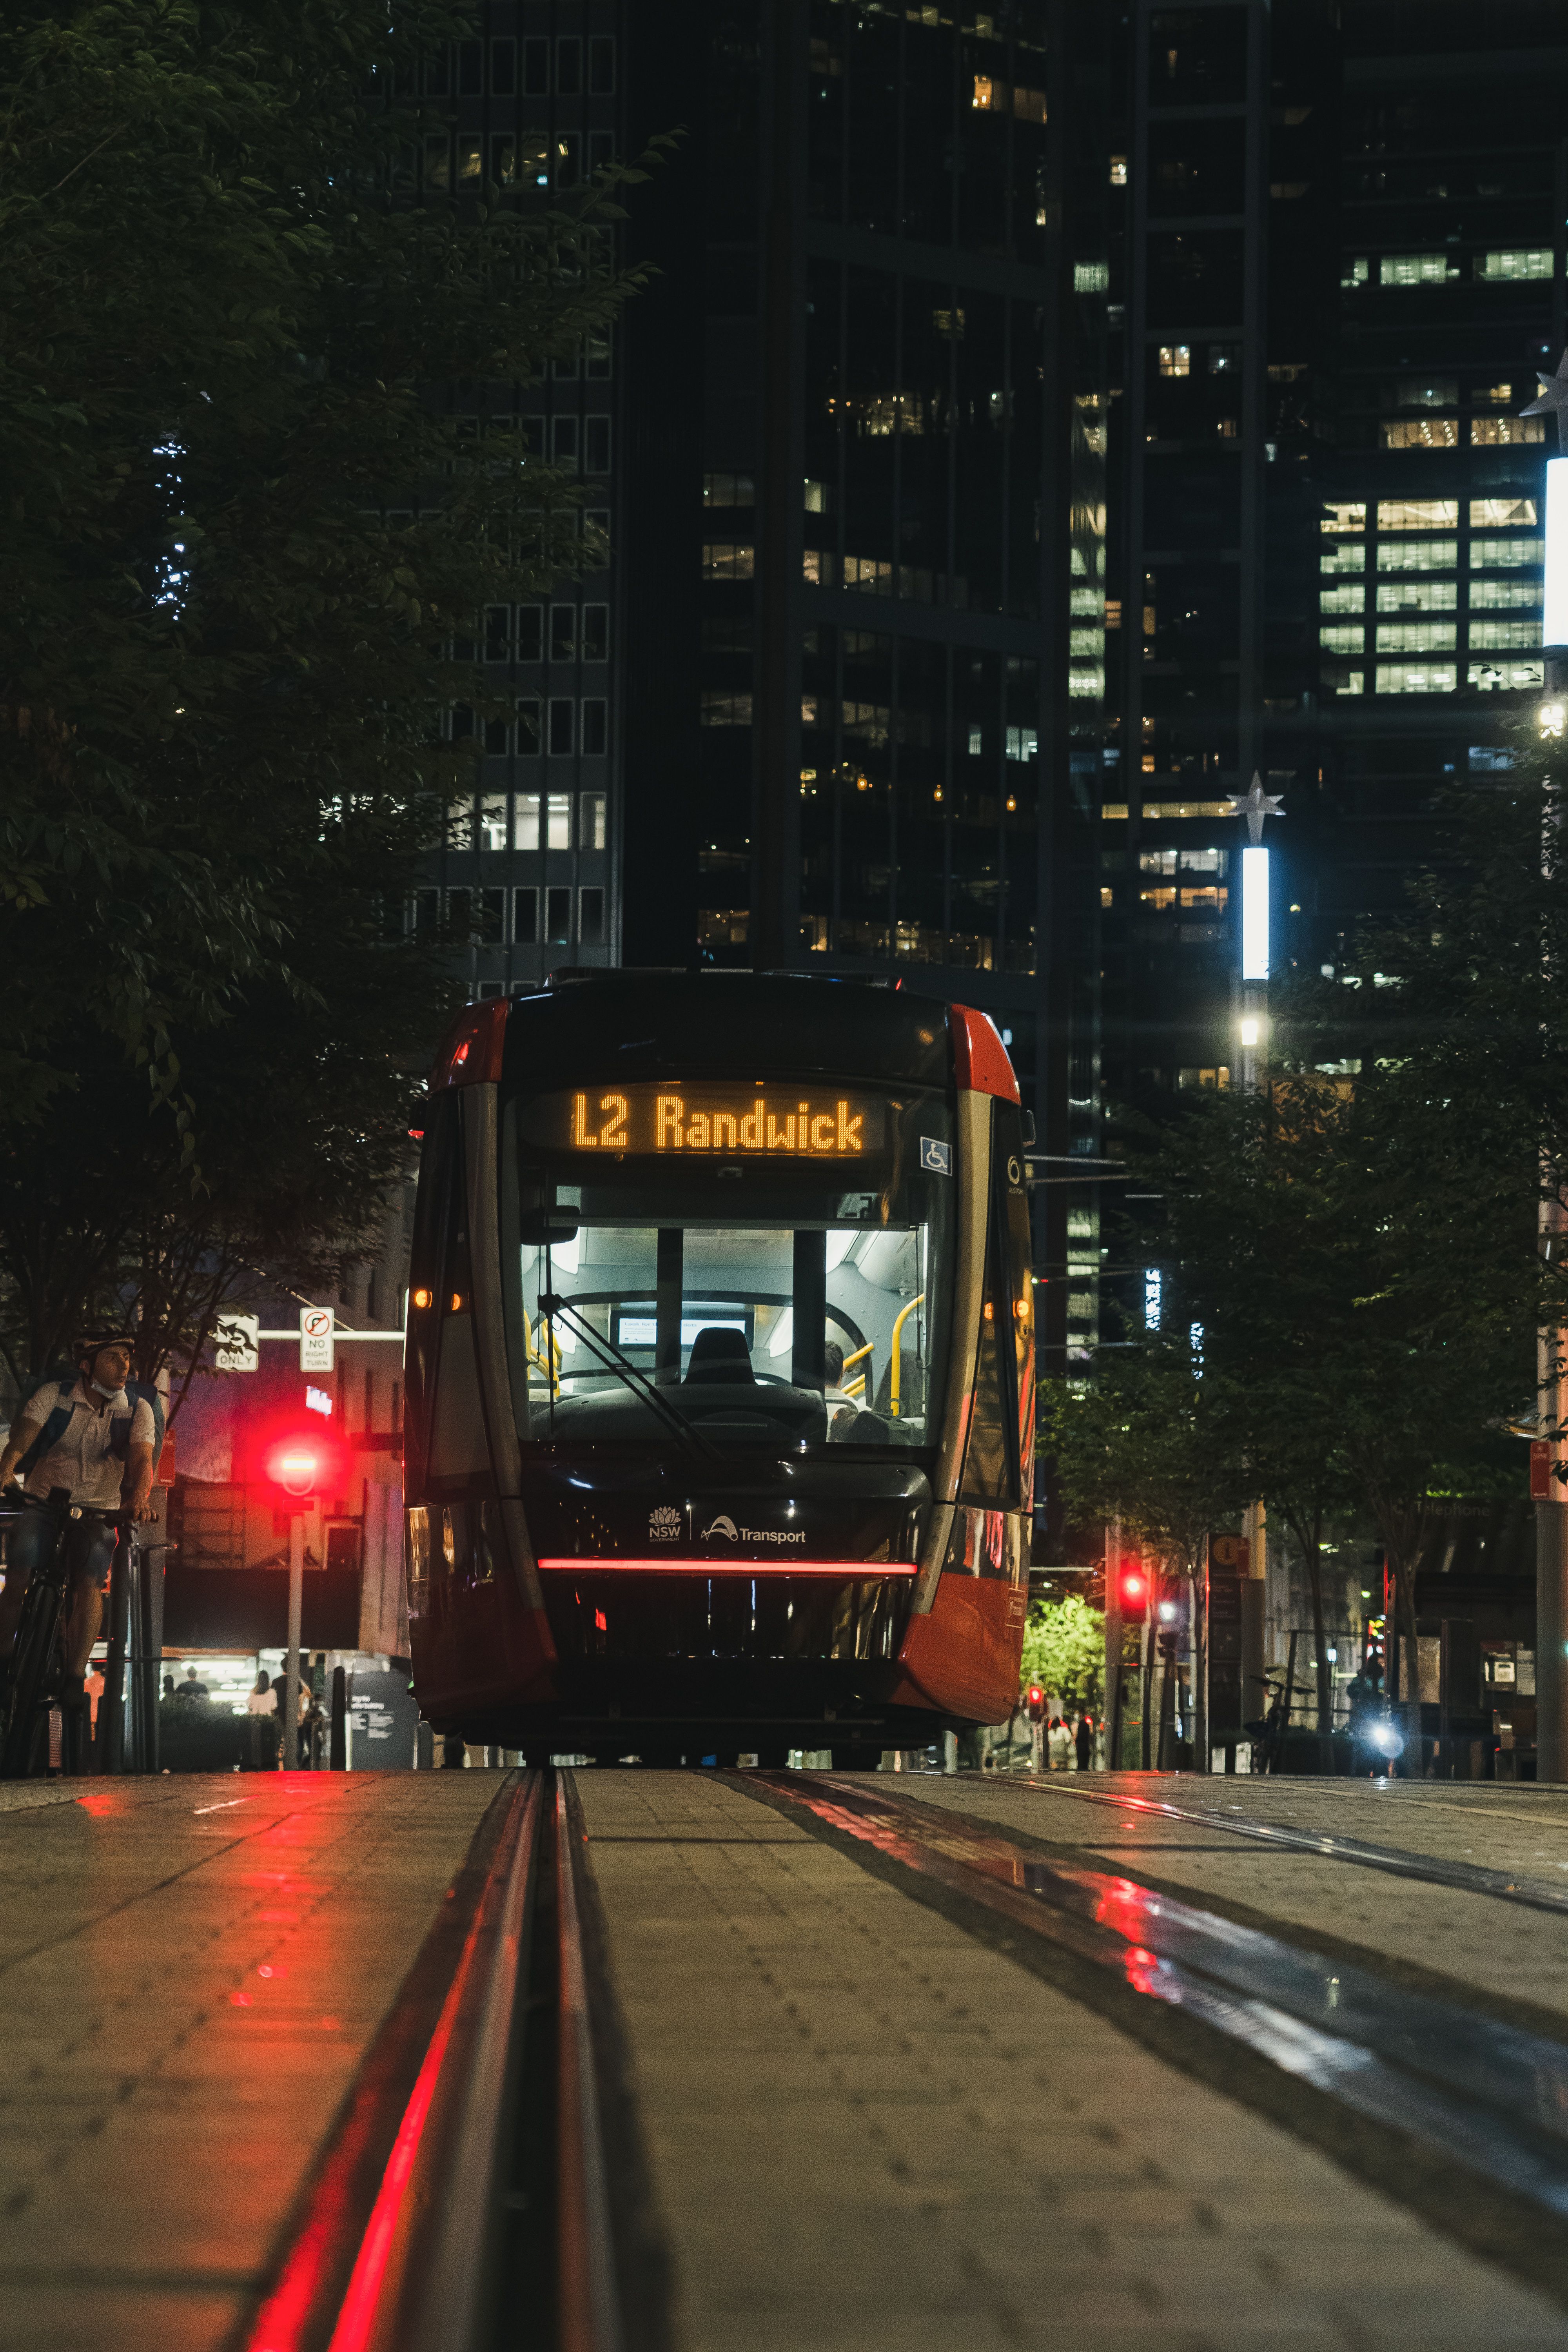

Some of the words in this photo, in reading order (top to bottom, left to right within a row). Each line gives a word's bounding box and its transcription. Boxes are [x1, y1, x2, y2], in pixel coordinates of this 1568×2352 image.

[575, 1094, 626, 1146] L2
[657, 1096, 862, 1150] Randwick
[309, 1339, 325, 1349] NO
[220, 1355, 253, 1365] ONLY
[650, 1526, 681, 1538] NSW
[740, 1528, 806, 1544] Transport
